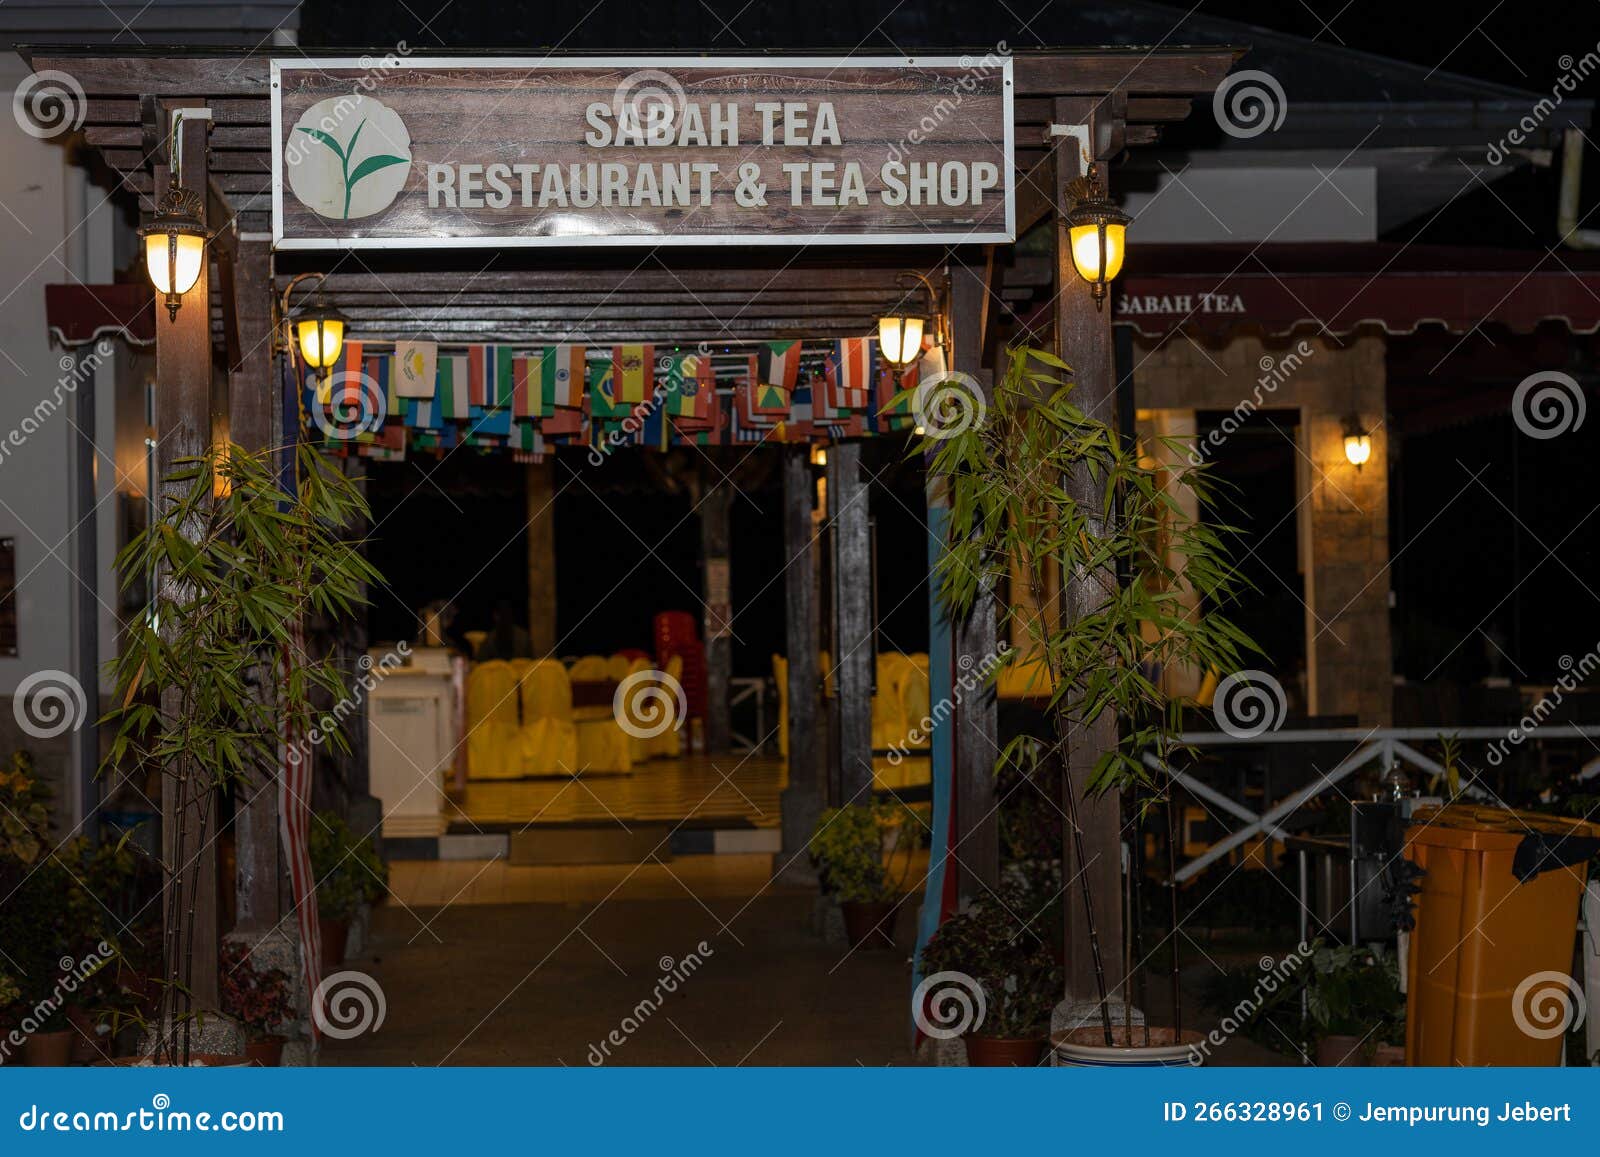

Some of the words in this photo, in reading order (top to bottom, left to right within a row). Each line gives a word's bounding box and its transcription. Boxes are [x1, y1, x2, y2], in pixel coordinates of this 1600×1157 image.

[585, 102, 739, 148] SABAH
[755, 102, 842, 147] TEA
[427, 163, 719, 208] RESTAURANT
[734, 162, 768, 208] &
[783, 163, 868, 207] TEA
[881, 160, 999, 207] SHOP
